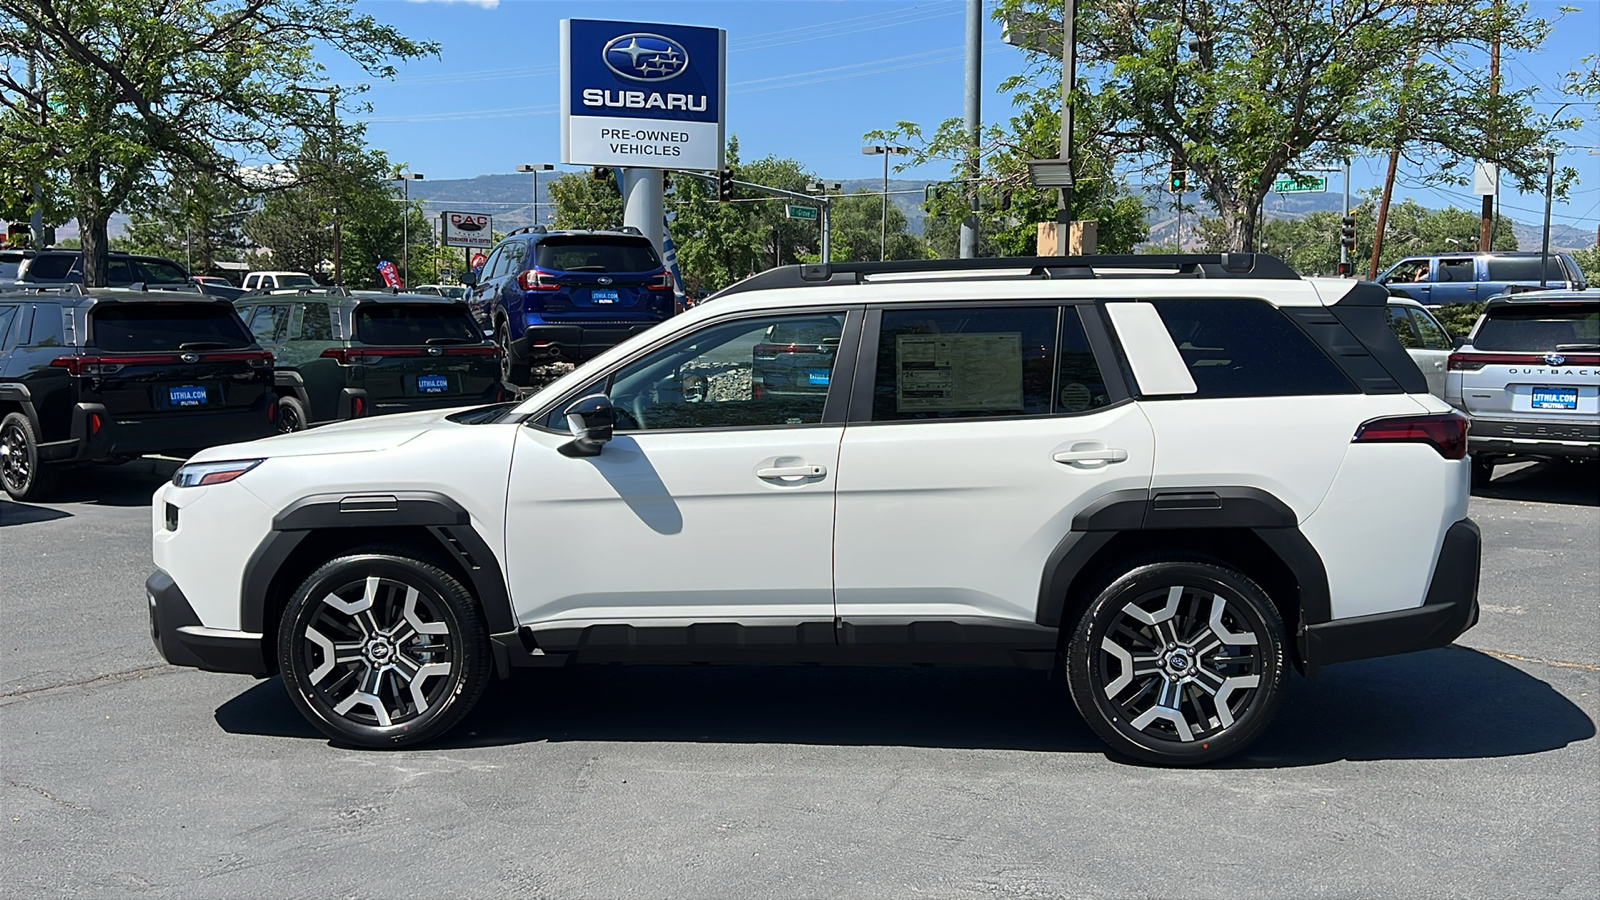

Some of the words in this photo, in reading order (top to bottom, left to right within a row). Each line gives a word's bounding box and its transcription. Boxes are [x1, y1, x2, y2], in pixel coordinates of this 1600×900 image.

[582, 88, 707, 112] SUBARU
[601, 128, 689, 143] PRE-OWNED
[610, 143, 681, 156] VEHICLES
[451, 214, 487, 225] CAC
[1508, 368, 1600, 376] OUTBACK
[418, 380, 448, 388] LITHIA.COM
[170, 390, 207, 400] LITHIA.COM
[1533, 393, 1577, 403] LITHIA.COM
